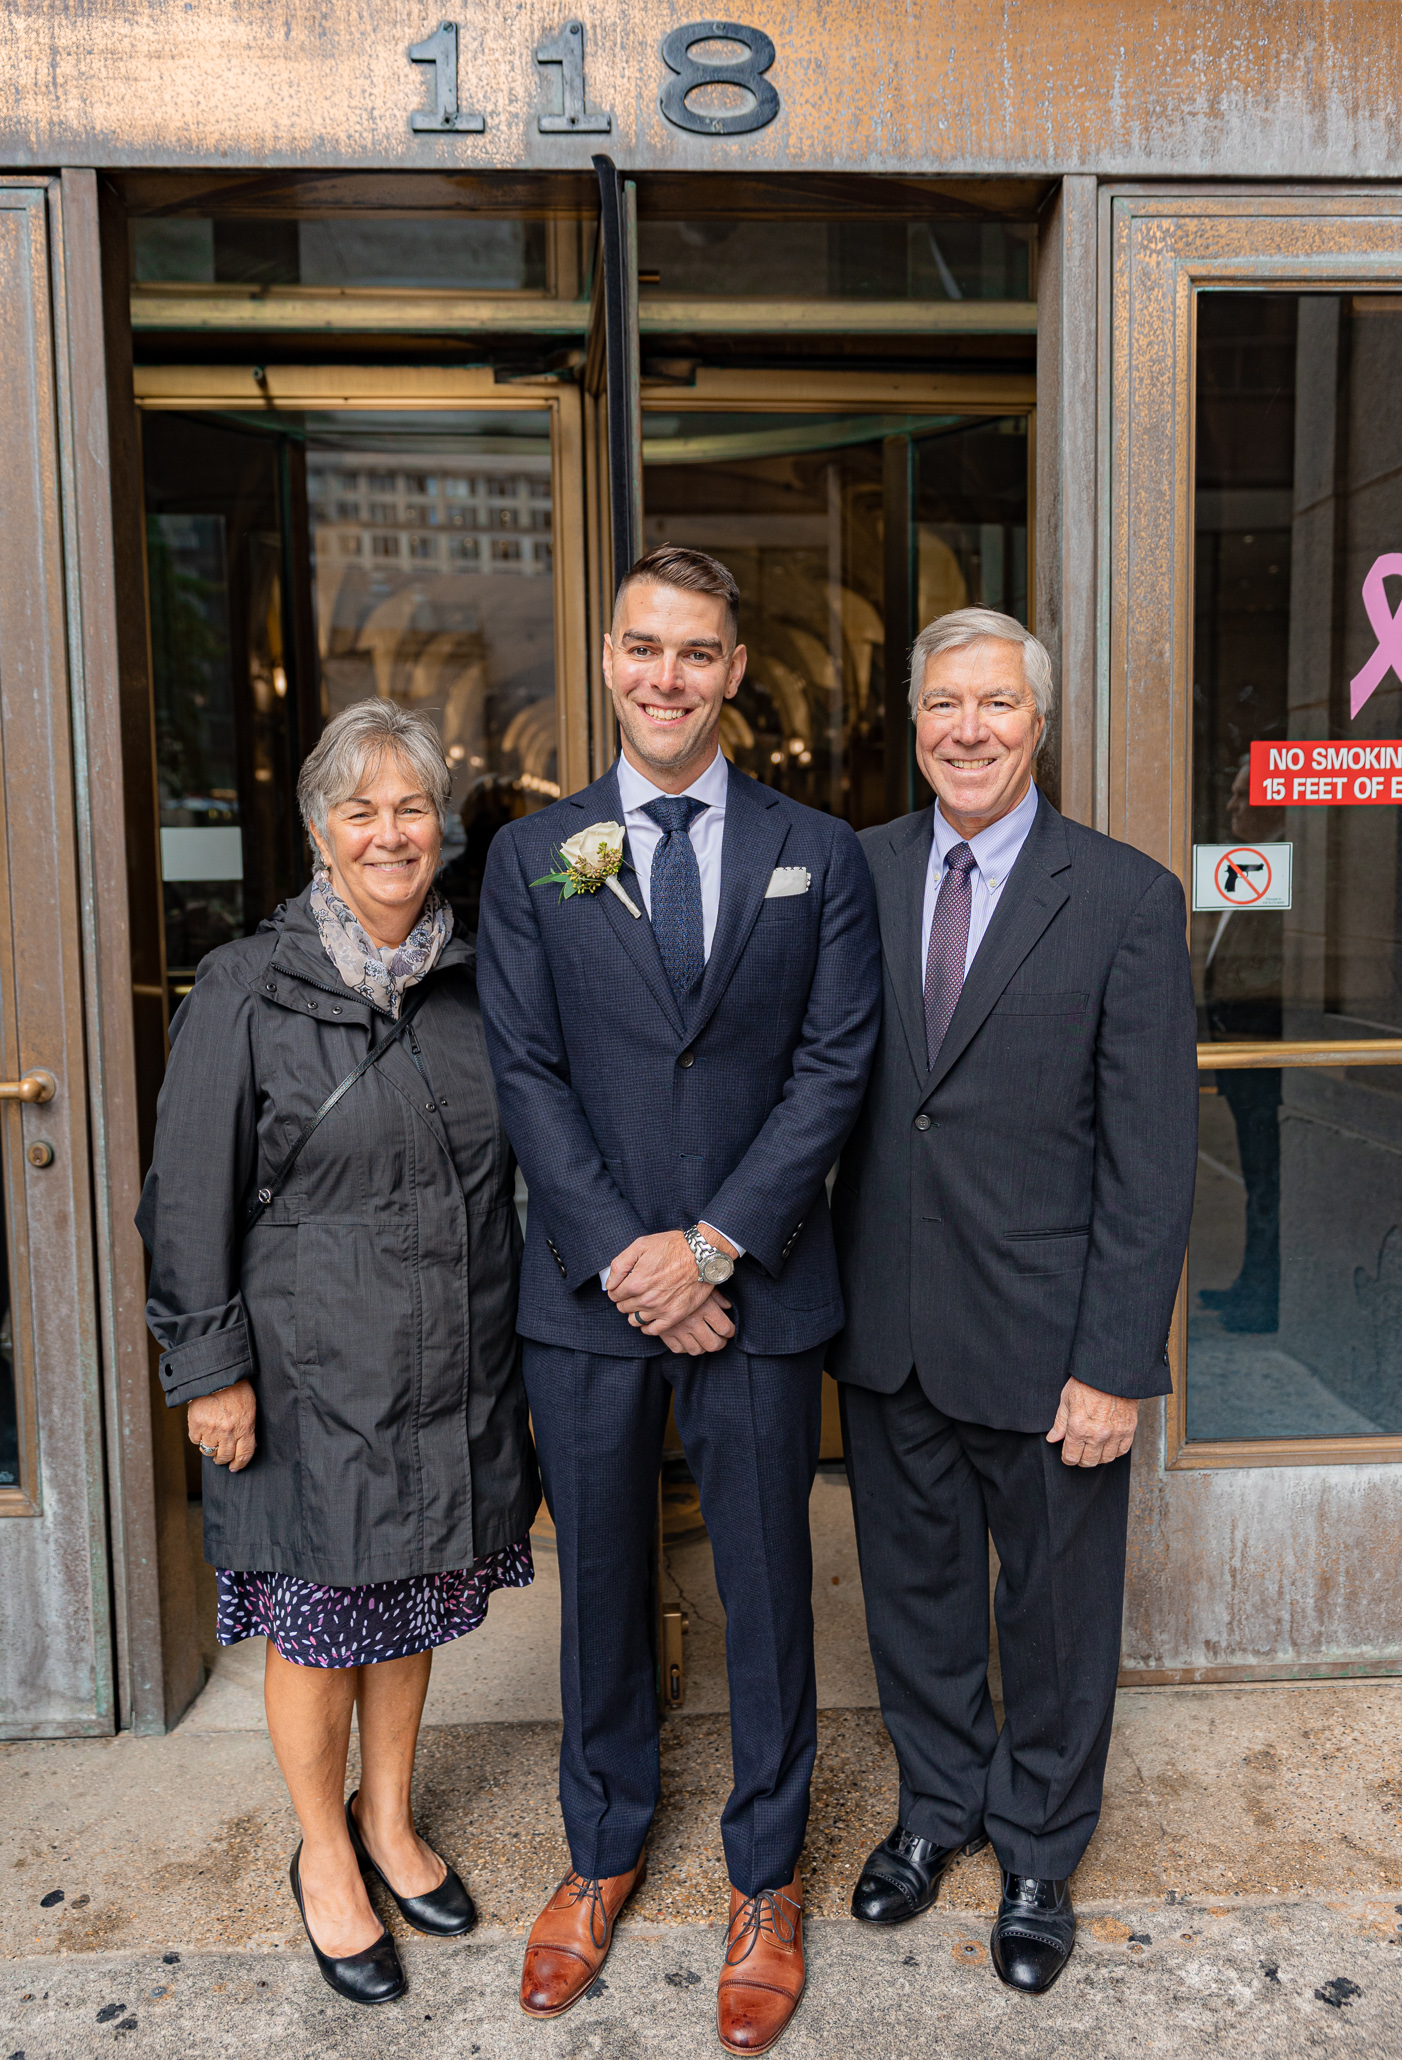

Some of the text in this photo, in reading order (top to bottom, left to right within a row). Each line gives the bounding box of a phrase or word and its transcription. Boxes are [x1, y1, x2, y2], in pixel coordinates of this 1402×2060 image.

[409, 20, 780, 134] 118
[1269, 746, 1402, 771] NO SMOKIN
[1262, 778, 1286, 800] 15
[1293, 777, 1348, 800] FEET
[1353, 776, 1385, 799] OF
